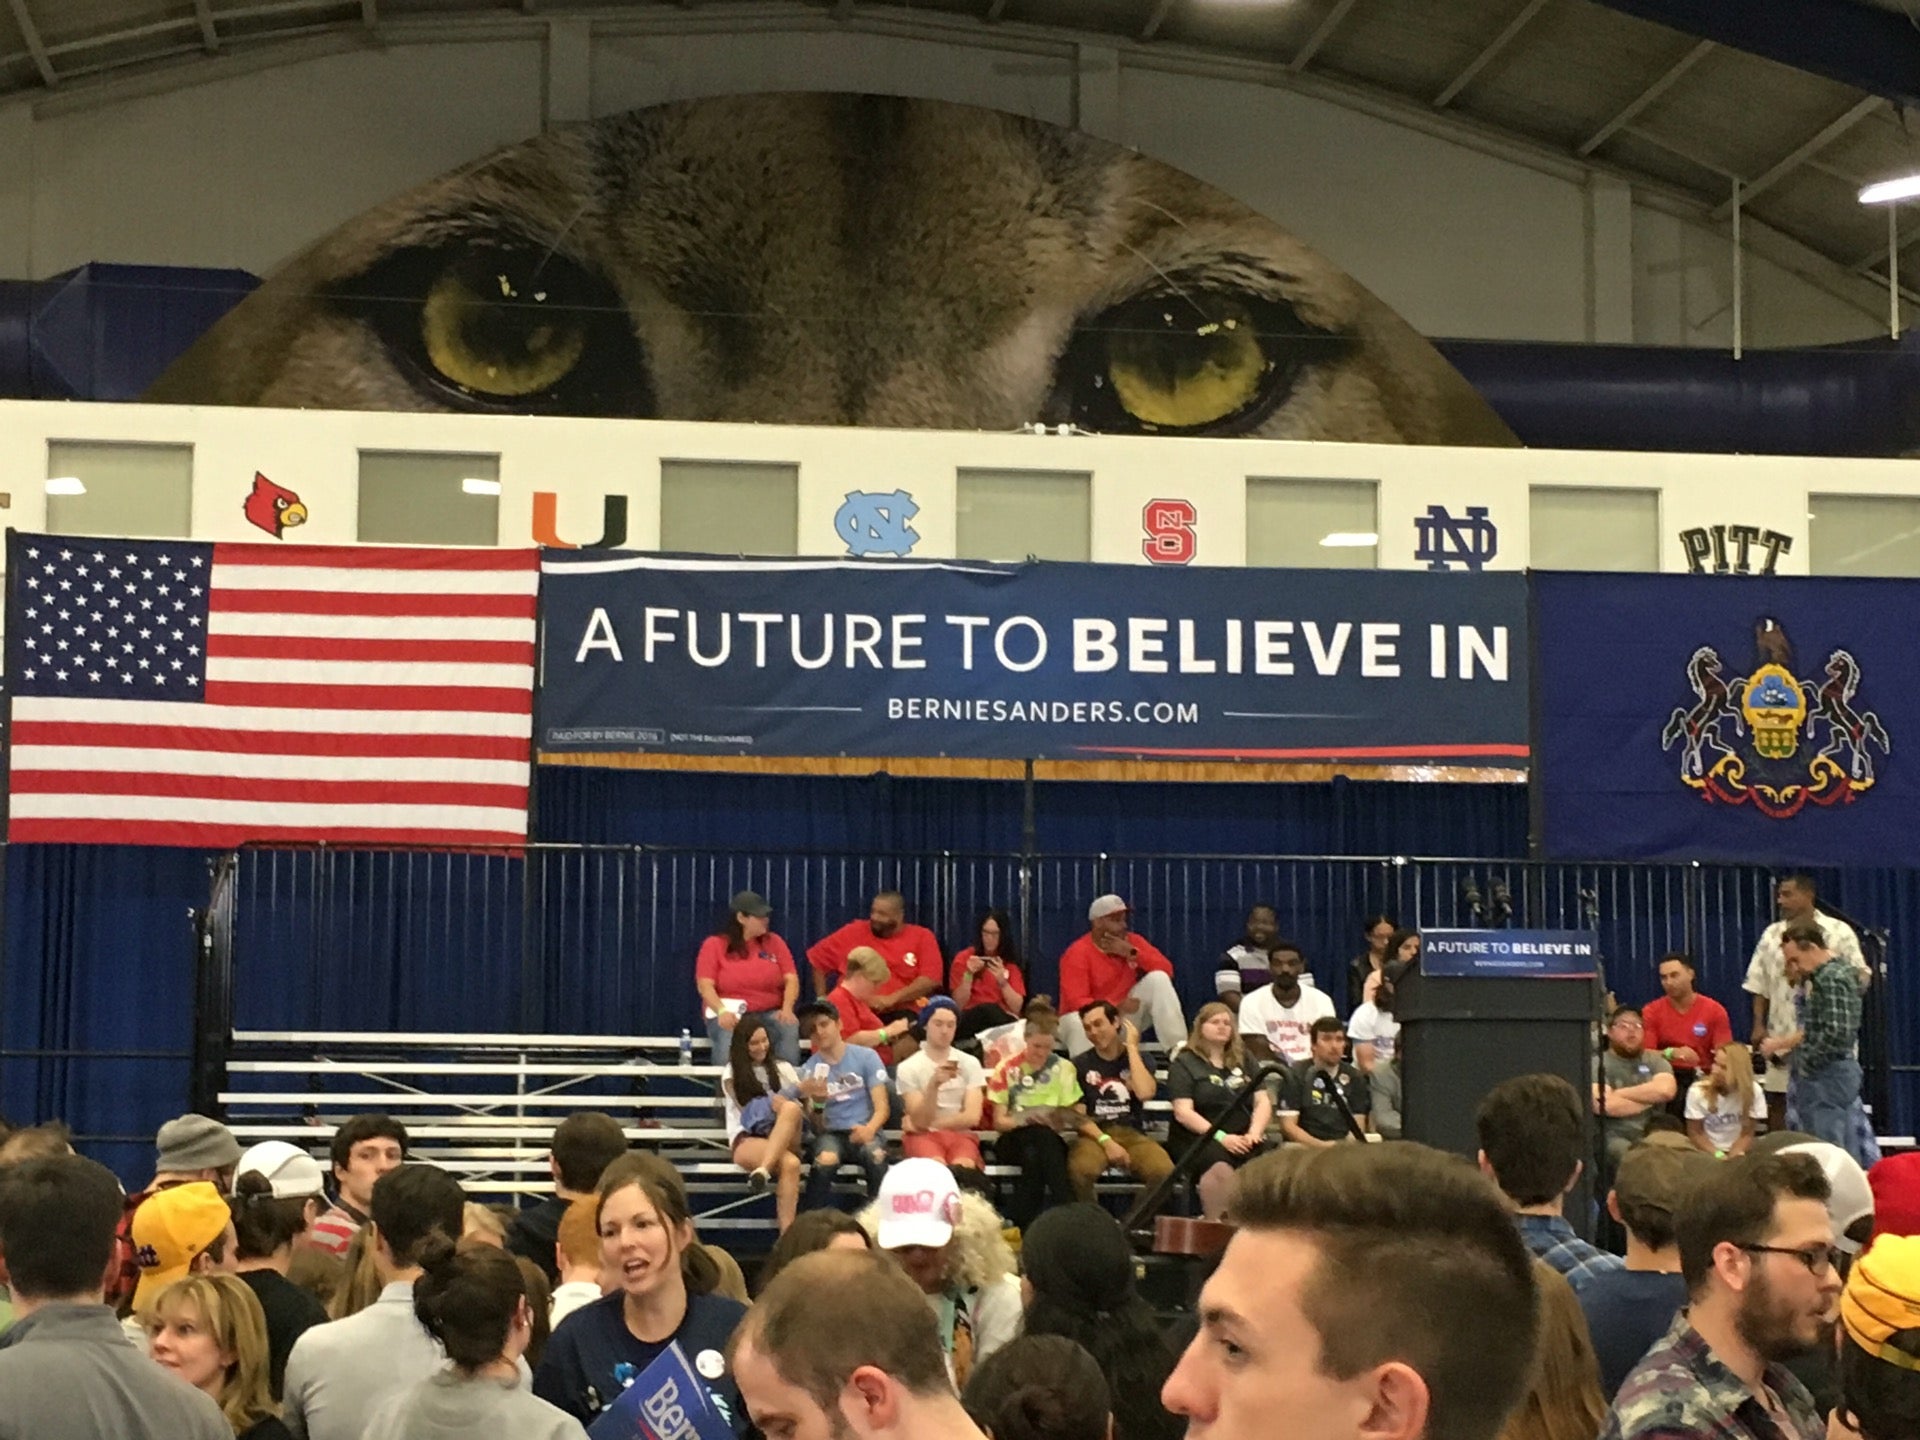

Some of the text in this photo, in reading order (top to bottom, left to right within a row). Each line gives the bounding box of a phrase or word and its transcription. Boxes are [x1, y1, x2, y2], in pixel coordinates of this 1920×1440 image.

[1679, 525, 1793, 574] PITT
[575, 607, 1509, 681] A FUTURE TO BELIEVE IN
[887, 697, 1199, 724] BERNIESANDERS.COM
[1426, 941, 1591, 955] A FUTURE TO BELIEVE IN
